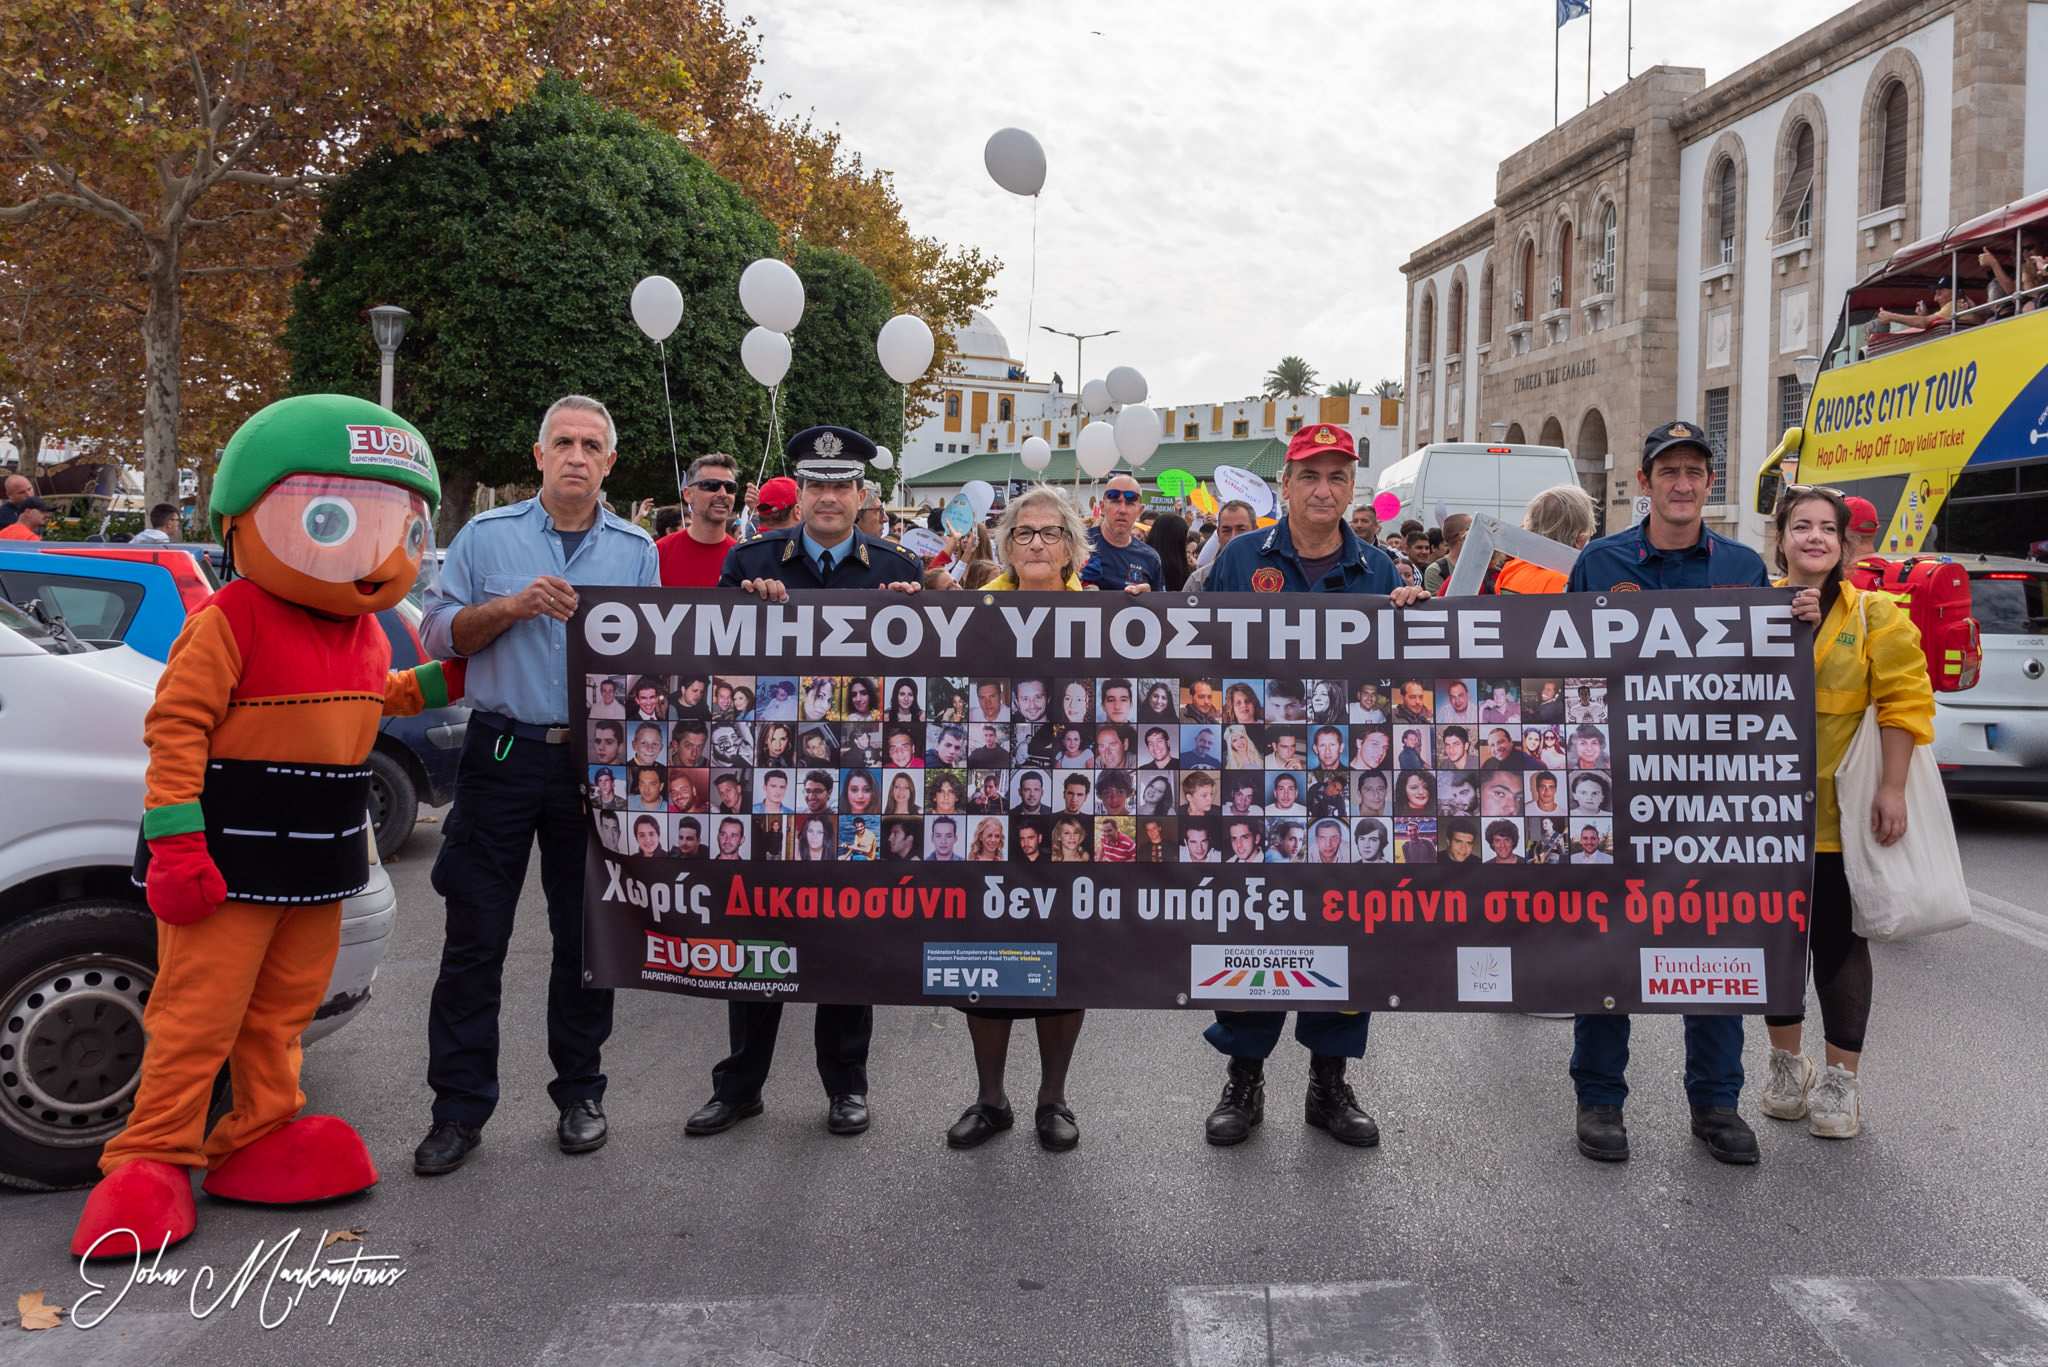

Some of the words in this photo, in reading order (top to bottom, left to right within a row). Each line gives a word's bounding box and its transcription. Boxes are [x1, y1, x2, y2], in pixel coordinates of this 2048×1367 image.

[1514, 375, 1542, 393] ΤΡΑΠΕΖΑ
[1546, 369, 1559, 386] ΤΗΣ
[1562, 358, 1596, 382] ΕΛΛΑΔΟΣ
[1813, 390, 1875, 436] RHODES
[1878, 381, 1920, 424] CITY
[1925, 360, 1978, 415] TOUR
[1816, 447, 1834, 469] Hop
[1835, 446, 1848, 464] On
[1854, 440, 1873, 464] Hop
[1875, 433, 1893, 458] Off
[1899, 438, 1915, 457] Day
[1916, 432, 1938, 452] Valid
[1939, 429, 1966, 448] Ticket
[584, 603, 975, 658] ΘΥΜΗΣΟΥ
[1000, 605, 1504, 660] ΥΠΟΣΤΗΡΙΞΕ
[1536, 605, 1796, 659] ΔΡΑΣΕ
[1624, 673, 1796, 701] ΠΑΓΚΟΣΜΙΑ
[1627, 714, 1798, 741] ΗΜΕΡΑ
[1629, 754, 1801, 781] ΜΝΗΜΗΣ
[1629, 794, 1803, 822] ΘΥΜΑΤΩΝ
[1630, 835, 1806, 863] ΤΡΟΧΑΙΩΝ
[602, 859, 711, 924] Χωρίς
[725, 874, 966, 919] Δικαιοσύνη
[983, 875, 1057, 919] δεν
[1072, 876, 1121, 919] θα
[1138, 876, 1307, 933] υπάρξει
[1322, 878, 1467, 934] ειρήνη
[1484, 889, 1608, 932] στους
[1625, 878, 1807, 936] δρόμους
[1224, 948, 1255, 956] DECADE
[1257, 948, 1267, 956] OF
[1224, 957, 1260, 969] ROAD
[1263, 957, 1314, 969] SAFETY
[1654, 954, 1751, 973] Fundación
[641, 970, 697, 988] ΠΑΡΑΤΗΡΗΤΗΡΙΟ
[698, 979, 727, 990] ΟΔΙΚΗΣ
[727, 981, 772, 992] ΑΣΦΑΛΕΙΑΣ
[772, 983, 799, 993] ΡΟΔΟΥ
[926, 967, 999, 988] FEVR
[1473, 982, 1497, 990] FICVI
[1648, 978, 1759, 996] MAPFRE
[1249, 988, 1266, 996] 2021
[1272, 988, 1290, 996] 2030
